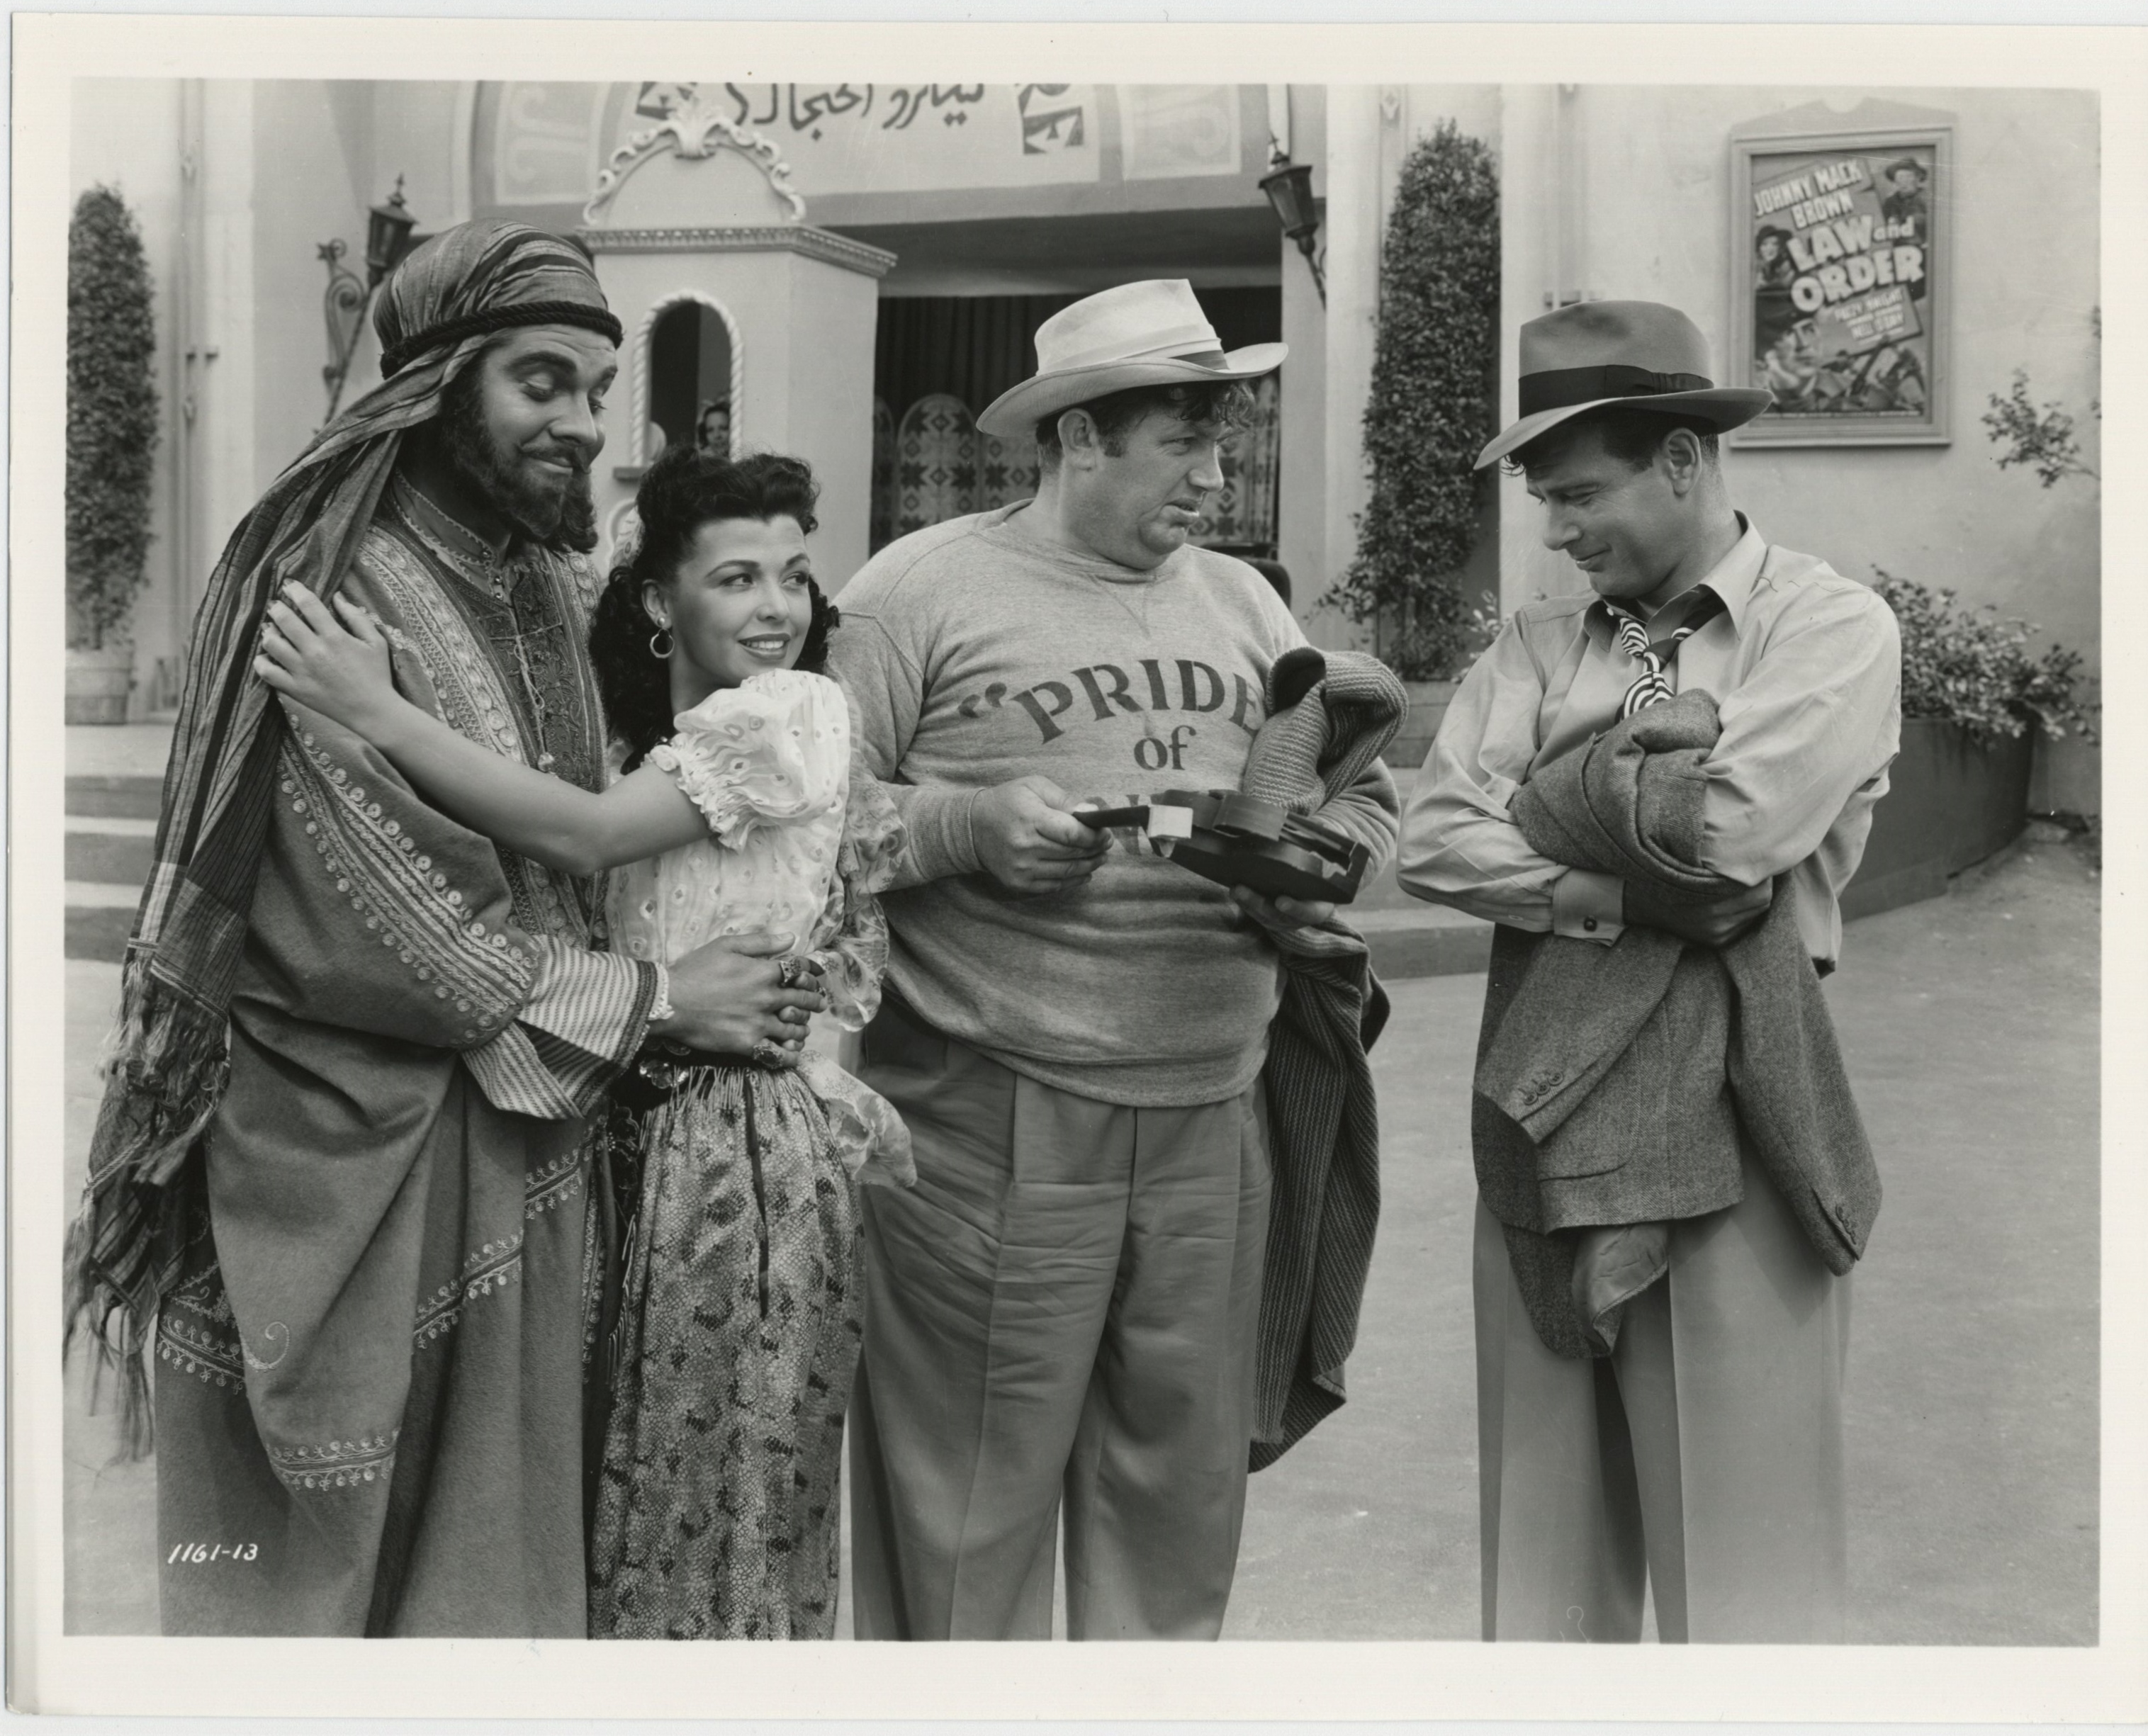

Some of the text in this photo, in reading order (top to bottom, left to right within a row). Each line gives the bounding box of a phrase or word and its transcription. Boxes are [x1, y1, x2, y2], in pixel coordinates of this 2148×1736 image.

[1754, 159, 1862, 216] JOHNNY MACK
[1791, 189, 1854, 230] BROWN
[1786, 214, 1914, 273] LAW and
[1791, 245, 1925, 312] ORDER
[1134, 725, 1197, 771] of
